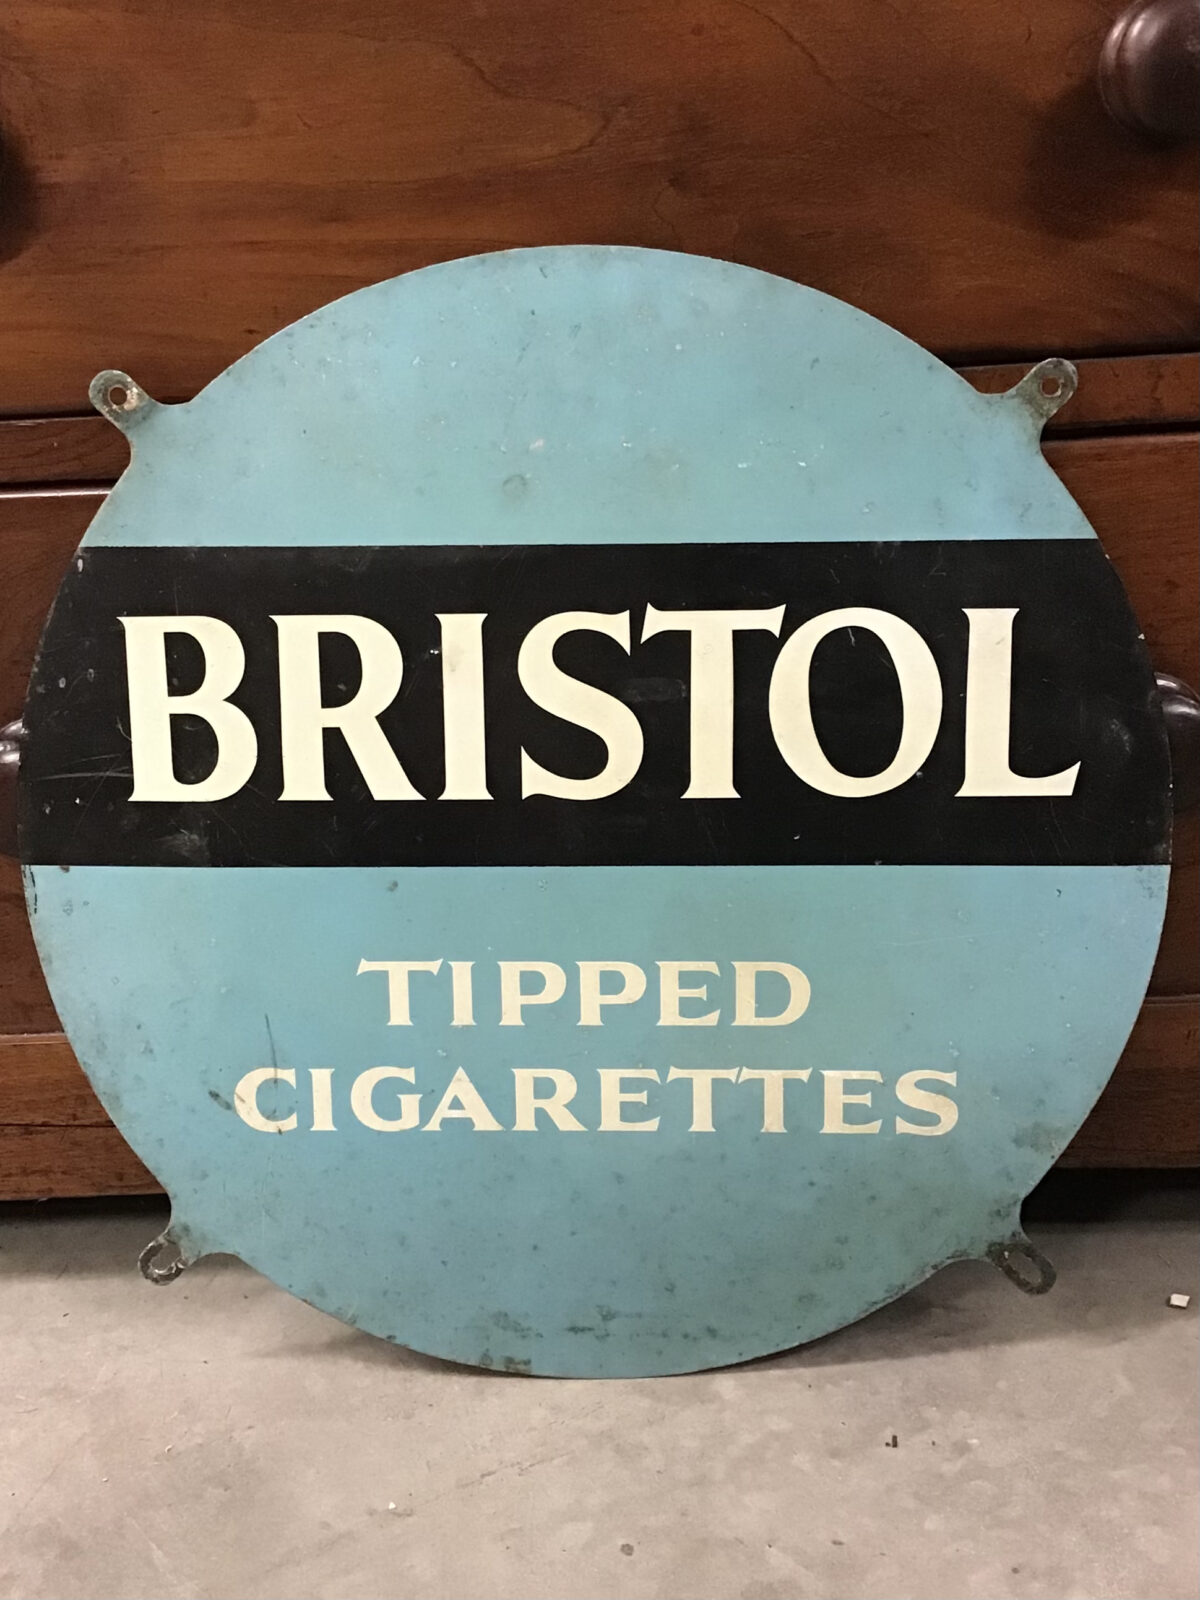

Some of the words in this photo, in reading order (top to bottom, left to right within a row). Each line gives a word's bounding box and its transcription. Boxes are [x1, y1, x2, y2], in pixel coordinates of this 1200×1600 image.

[117, 603, 1081, 803] BRISTOL
[356, 958, 812, 1028] TIPPED
[233, 1066, 960, 1136] CIGARETTES
